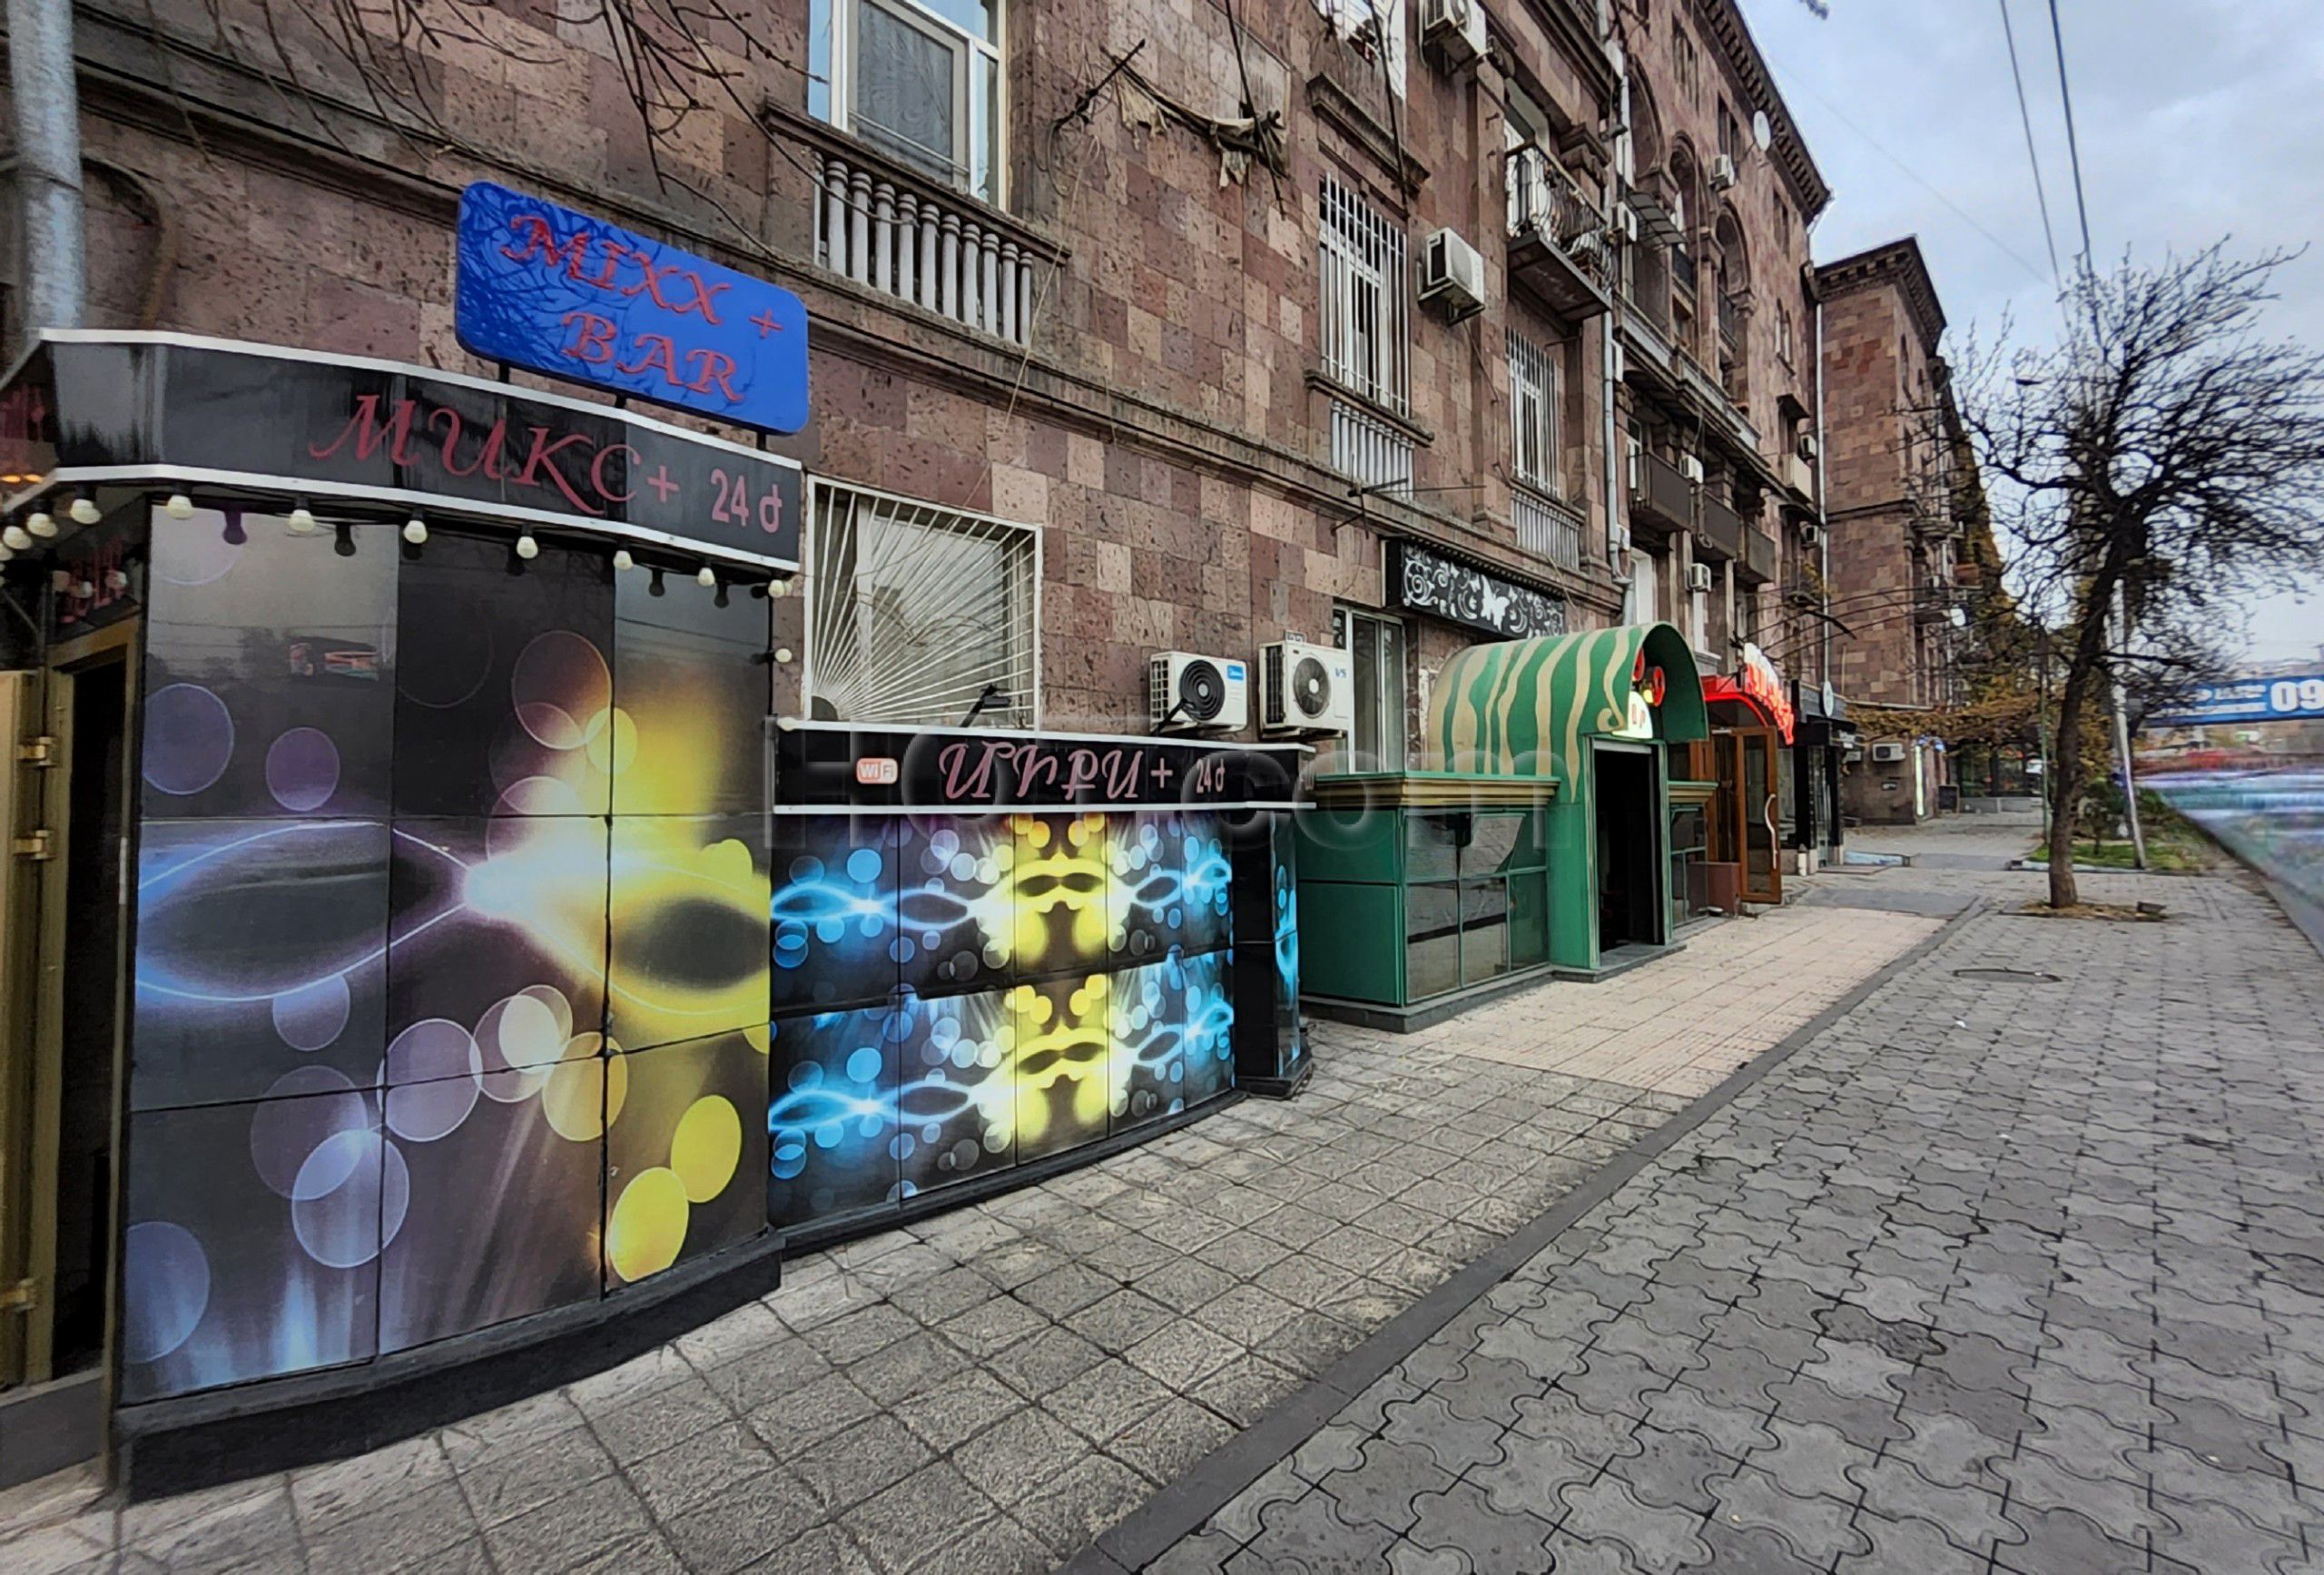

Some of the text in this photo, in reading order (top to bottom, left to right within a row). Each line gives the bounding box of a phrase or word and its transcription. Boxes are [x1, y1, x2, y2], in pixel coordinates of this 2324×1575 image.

[499, 214, 734, 326] MIXX
[561, 311, 744, 402] BAR
[307, 394, 643, 516] МИКС
[710, 468, 750, 527] 24
[1196, 759, 1213, 794] 24
